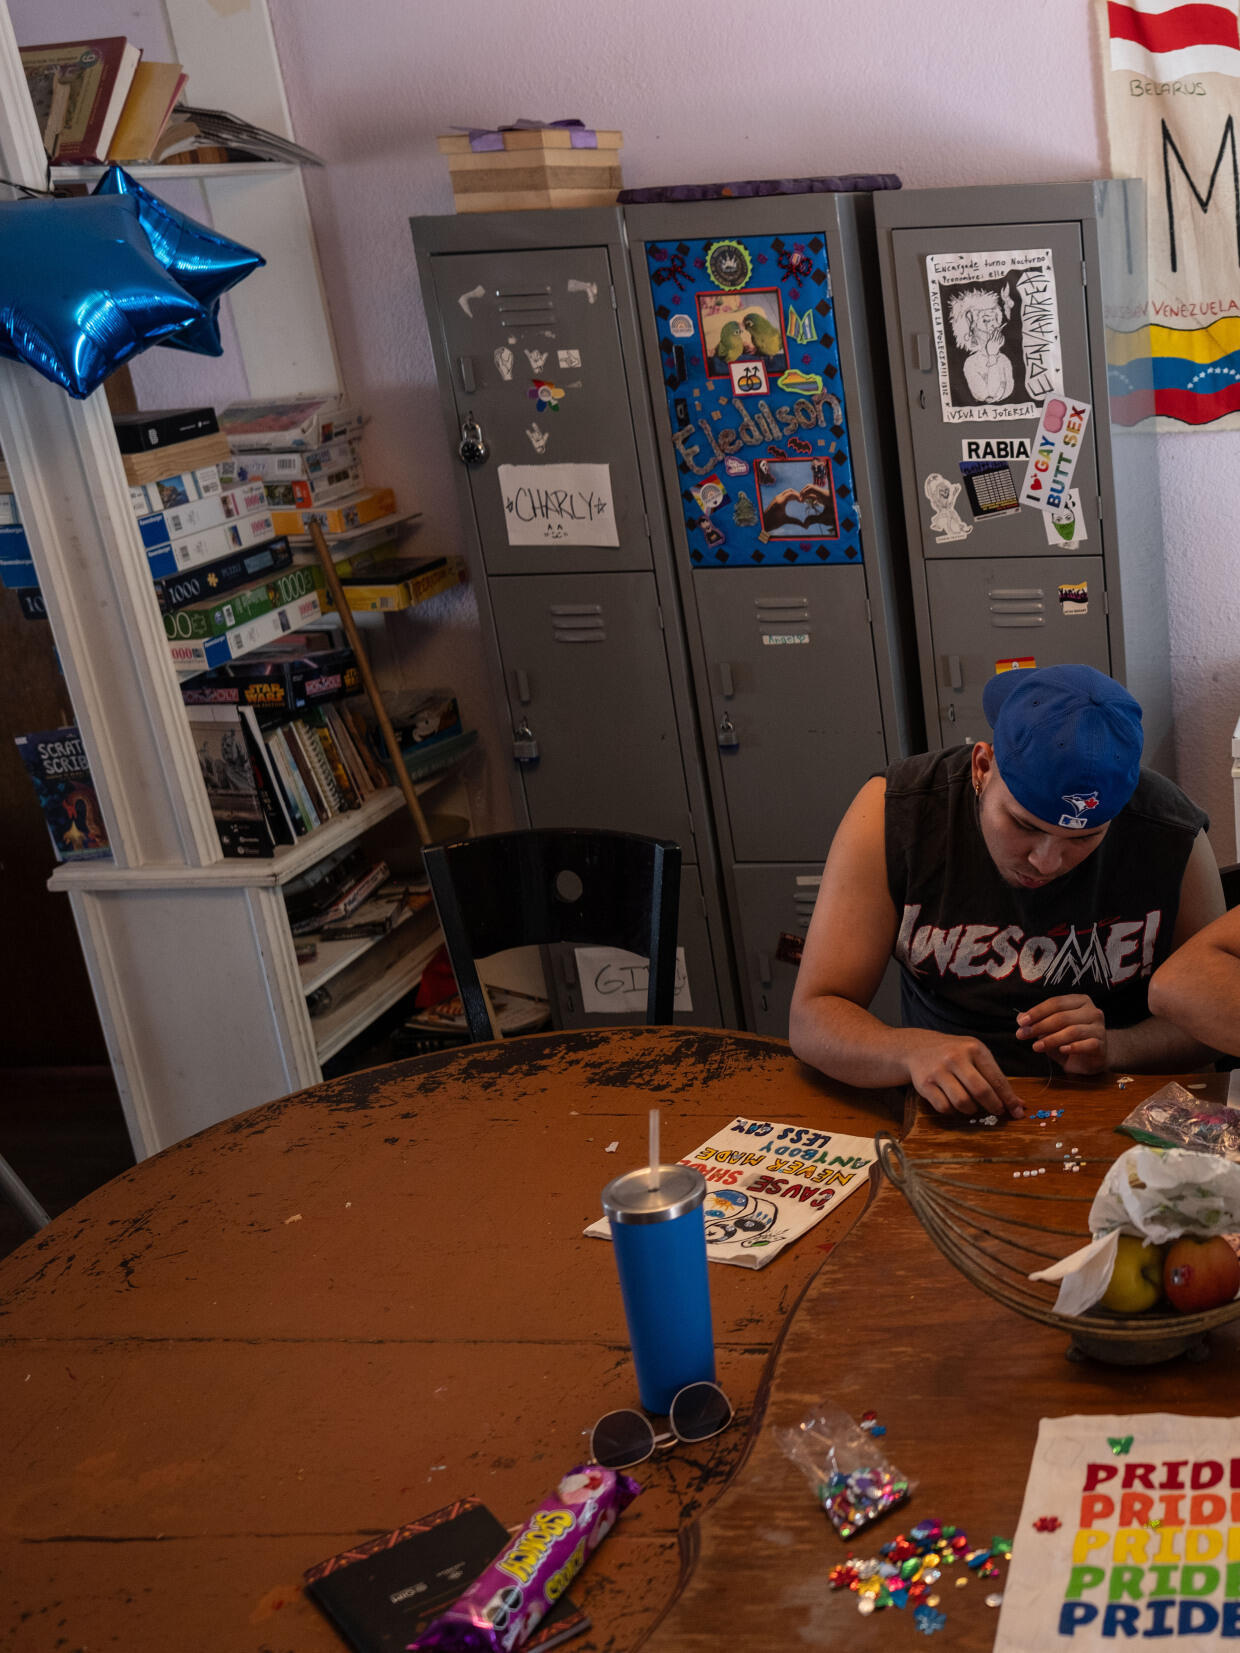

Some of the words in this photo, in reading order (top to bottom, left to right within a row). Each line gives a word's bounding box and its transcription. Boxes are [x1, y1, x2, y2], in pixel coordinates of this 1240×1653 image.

[1129, 79, 1207, 97] BELARUS
[934, 261, 980, 274] Encargade
[984, 258, 1006, 268] turno
[1010, 255, 1046, 266] Nocturno
[988, 269, 1005, 278] elle
[1152, 299, 1240, 318] VENEZUELA
[977, 409, 988, 418] LA
[967, 441, 1029, 459] RABIA
[1034, 435, 1056, 473] GAY
[1046, 451, 1073, 509] BUTT
[1062, 405, 1087, 448] SEX
[515, 487, 594, 522] CHARLY
[169, 578, 201, 604] 1000
[278, 571, 306, 602] 1000
[171, 648, 193, 660] 000
[37, 739, 85, 759] SCRAT
[43, 755, 90, 775] SCRIB
[897, 904, 1161, 990] AWESOME!
[730, 1118, 774, 1137] GAY
[776, 1127, 833, 1149] LESS
[695, 1147, 766, 1167] MADE
[759, 1140, 872, 1170] ANYBODY
[766, 1157, 857, 1187] NEVER
